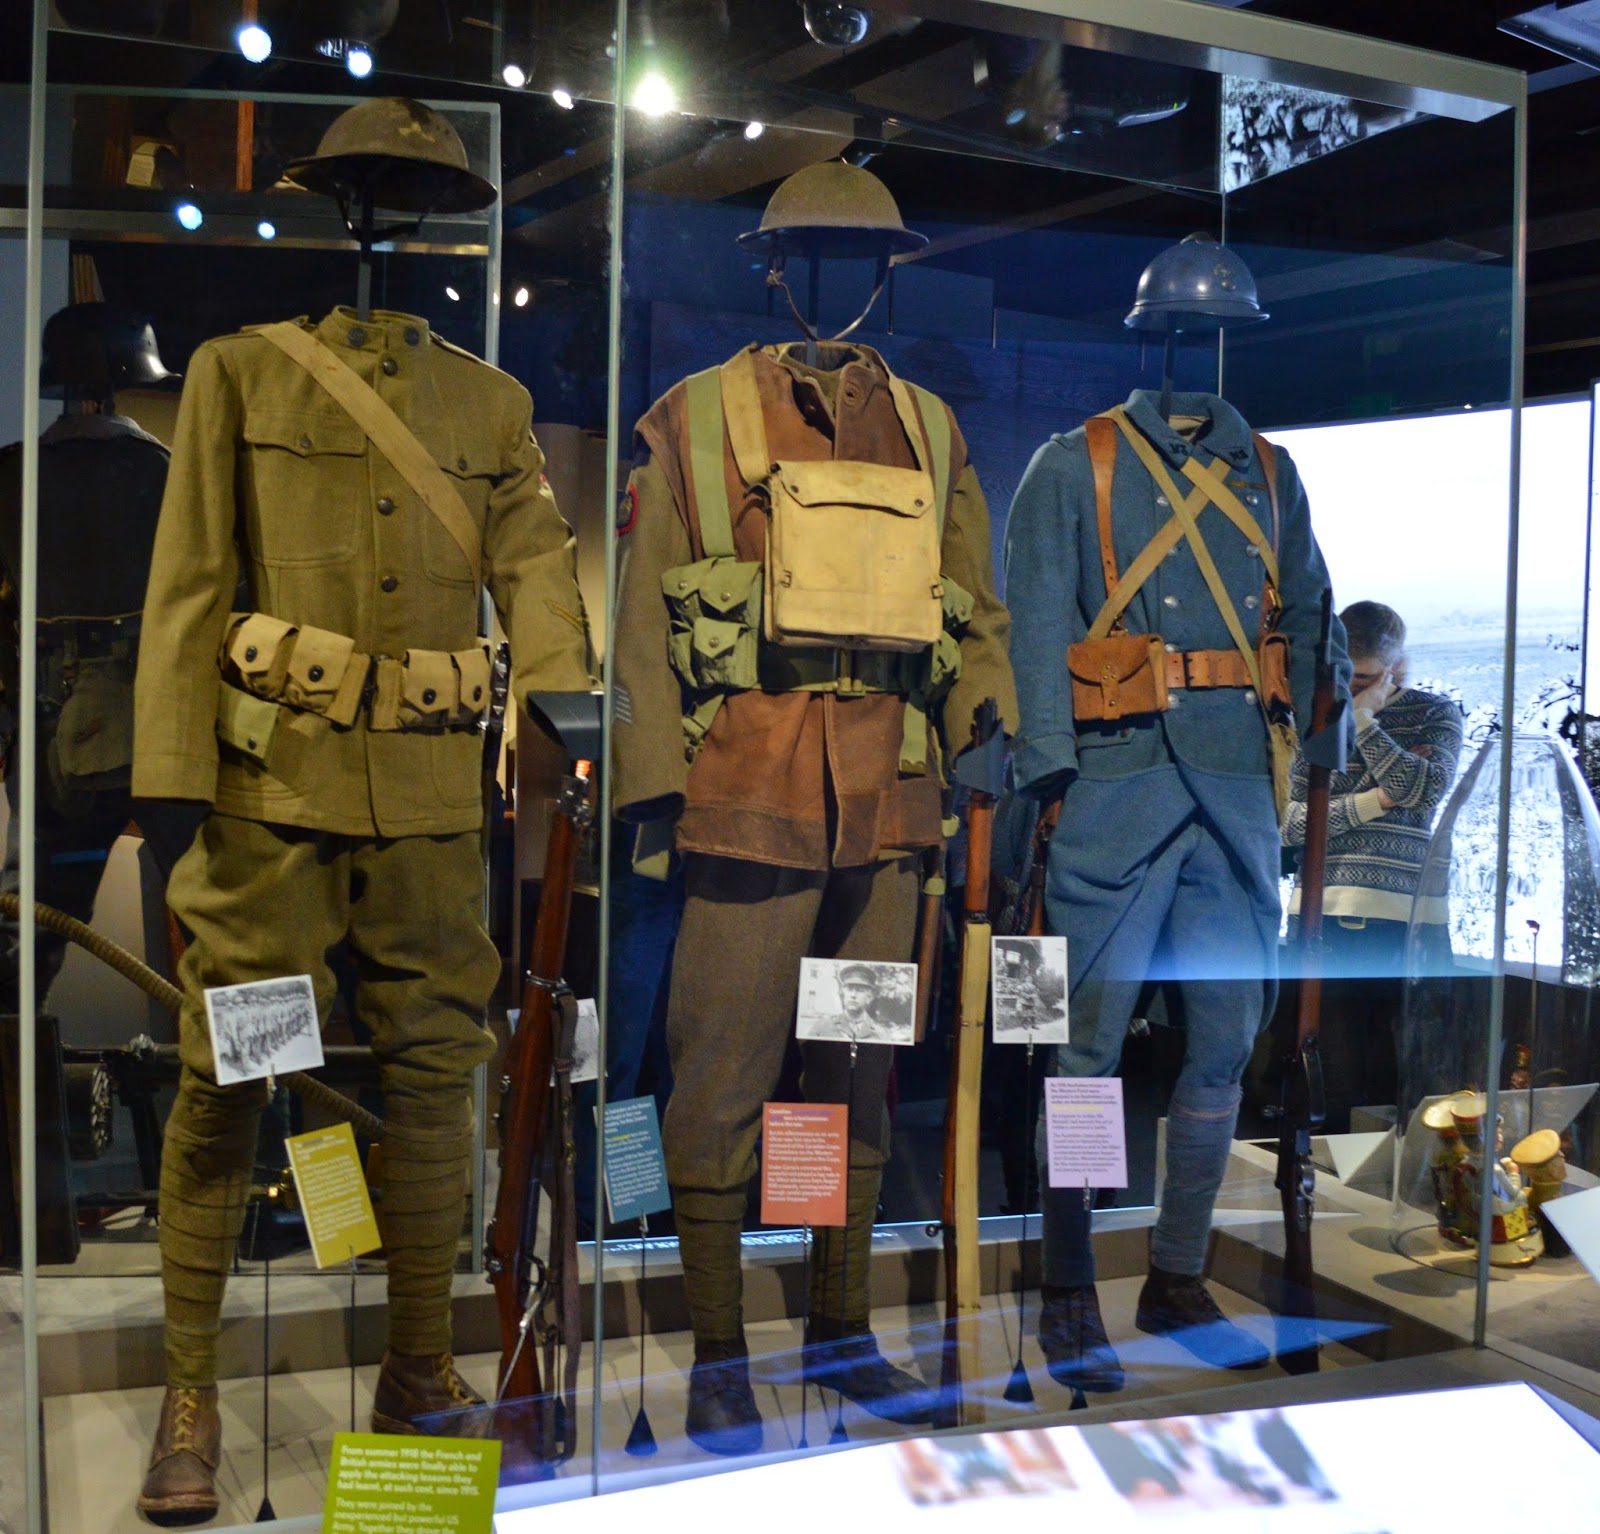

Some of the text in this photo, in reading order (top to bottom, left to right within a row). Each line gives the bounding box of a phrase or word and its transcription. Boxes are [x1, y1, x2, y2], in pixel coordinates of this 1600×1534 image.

[341, 1445, 364, 1455] From
[400, 1448, 419, 1457] 1918
[420, 1448, 433, 1458] the
[435, 1449, 464, 1459] French
[466, 1451, 482, 1460] and
